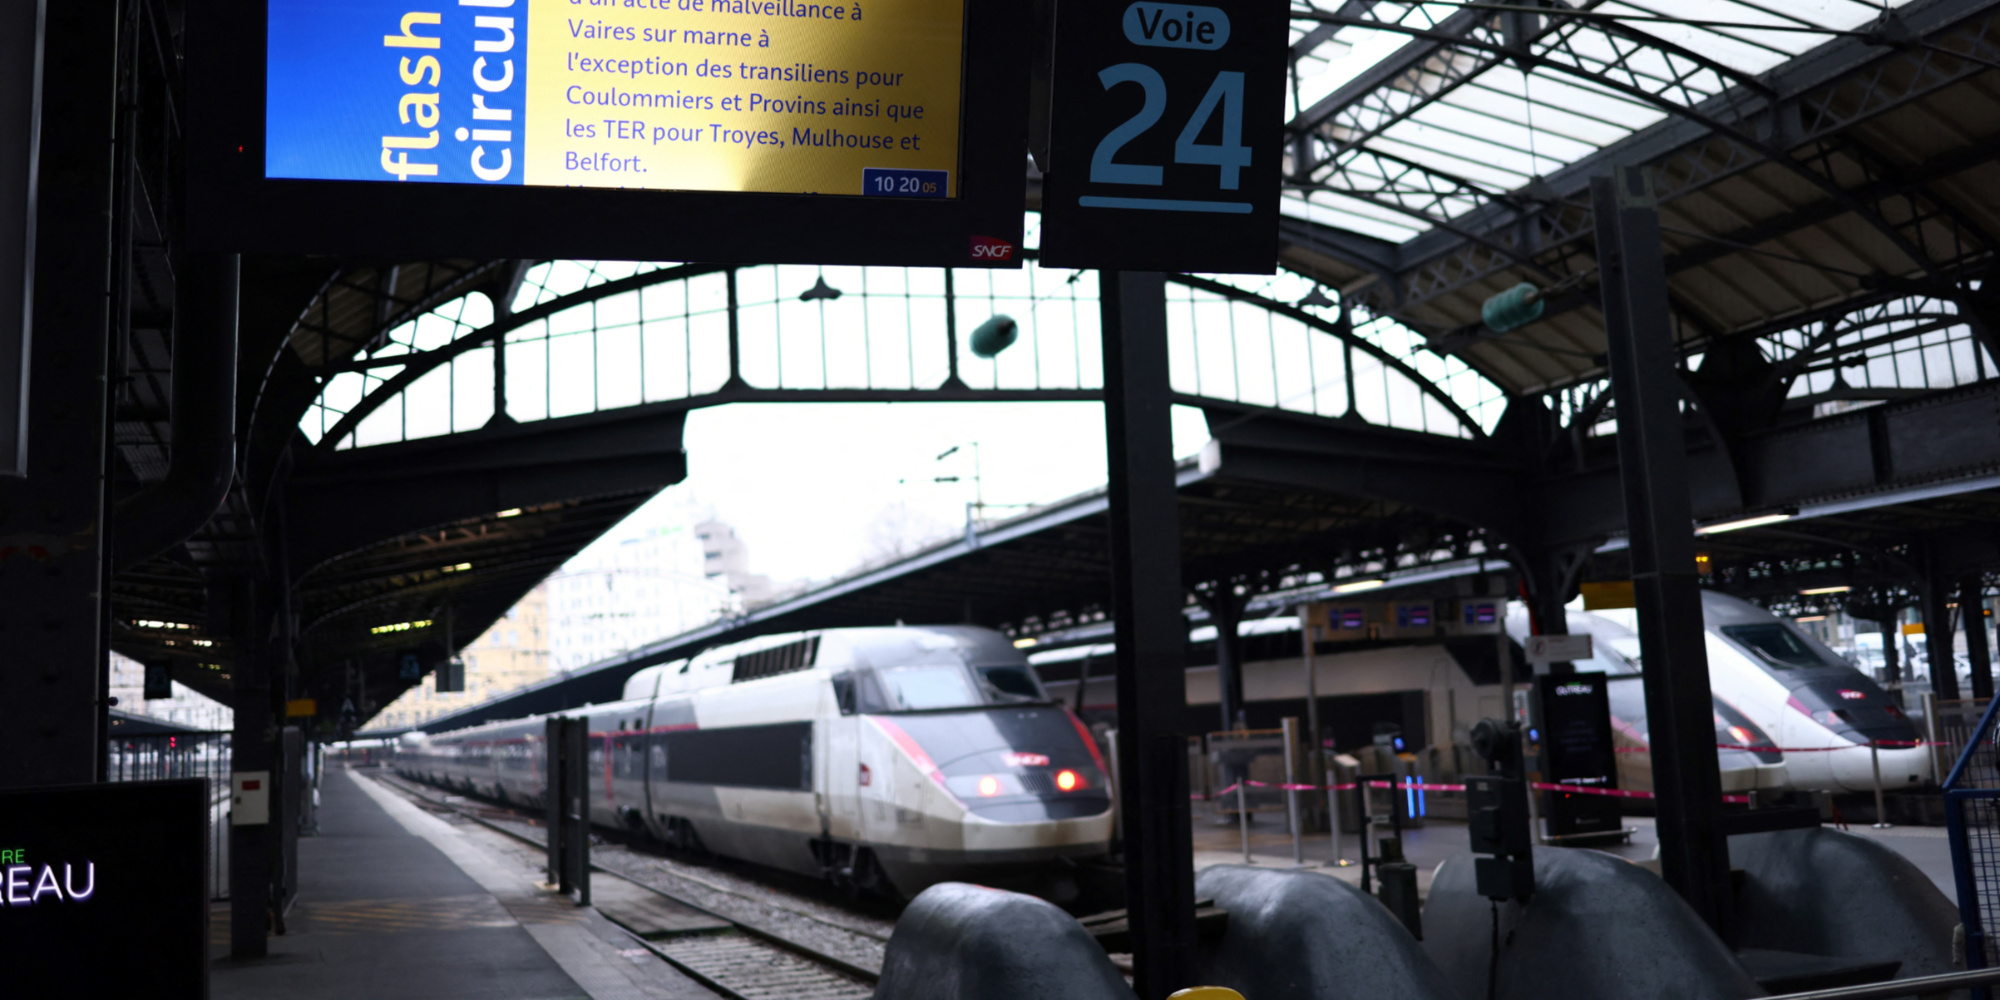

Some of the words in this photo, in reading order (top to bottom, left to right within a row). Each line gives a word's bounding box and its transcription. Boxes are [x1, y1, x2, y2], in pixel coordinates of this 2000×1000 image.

[712, 0, 844, 19] malveillance
[851, 3, 861, 20] à
[1137, 8, 1215, 44] Voie
[568, 19, 635, 41] Vaires
[643, 28, 676, 42] sur
[684, 30, 751, 47] marne
[758, 29, 769, 47] à
[568, 52, 687, 79] l'exception
[696, 59, 732, 78] des
[739, 63, 848, 83] transiliens
[857, 72, 903, 89] pour
[380, 11, 441, 181] flash
[566, 85, 713, 110] Coulommiers
[721, 95, 742, 111] et
[750, 93, 826, 114] Provins
[833, 98, 879, 116] ainsi
[887, 105, 923, 122] que
[566, 118, 596, 138] les
[603, 120, 645, 140] TER
[653, 127, 703, 145] pour
[709, 124, 784, 148] Troyes,
[793, 128, 893, 149] Mulhouse
[901, 135, 920, 150] et
[1090, 63, 1253, 190] 24
[565, 151, 647, 173] Belfort.
[875, 177, 894, 192] 10
[899, 177, 920, 193] 20
[922, 183, 937, 193] 05
[972, 245, 1011, 257] SNCF
[1, 849, 25, 864] RE
[0, 862, 94, 903] EAU
